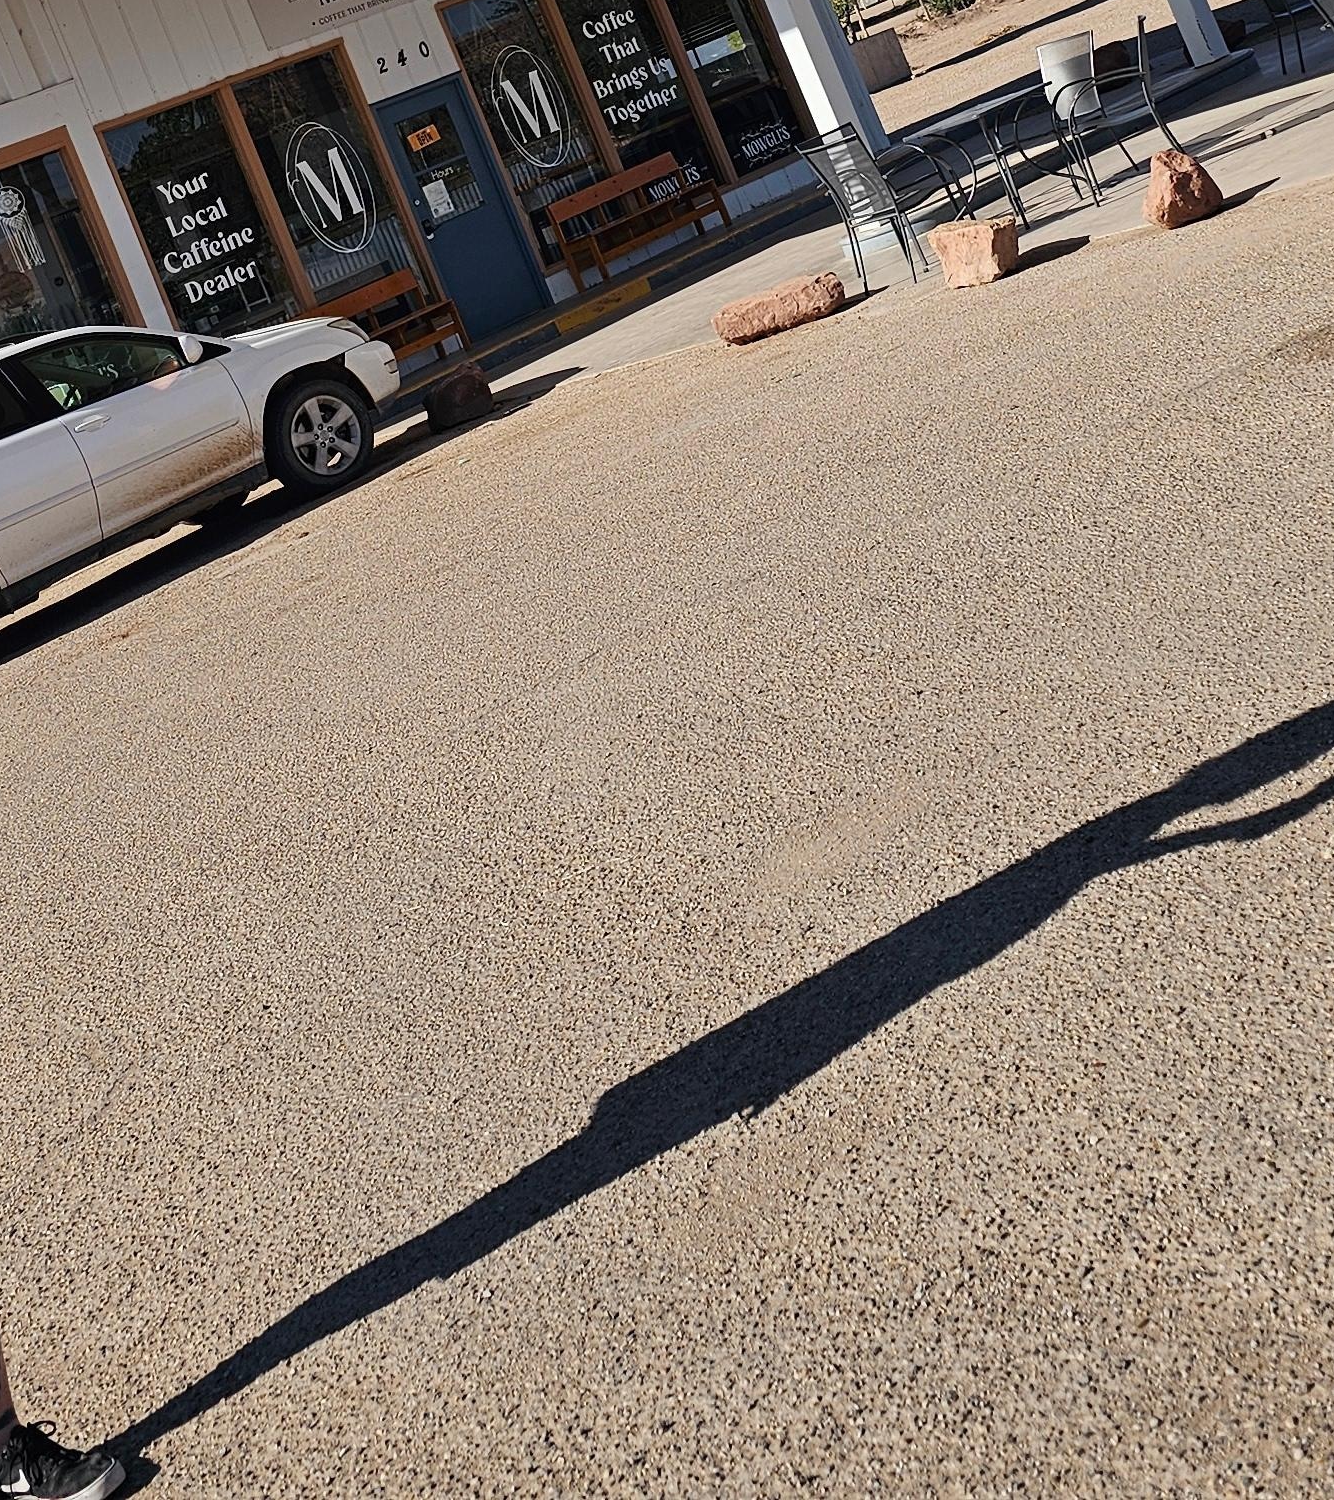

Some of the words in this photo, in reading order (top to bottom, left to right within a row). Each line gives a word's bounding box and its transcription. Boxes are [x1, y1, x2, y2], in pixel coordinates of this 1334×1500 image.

[319, 9, 347, 25] COFFEE
[347, 3, 367, 15] THAT
[582, 8, 636, 39] Coffee
[599, 36, 641, 64] That
[593, 63, 649, 100] Brings
[647, 54, 669, 77] Us
[500, 69, 560, 144] M
[603, 84, 678, 126] Together
[742, 125, 791, 160] MOWGLI'S
[156, 172, 209, 205] Your
[296, 146, 365, 229] M
[430, 166, 454, 180] Hours
[648, 166, 701, 201] MOWI'S
[165, 196, 228, 238] Local
[163, 227, 255, 274] Caffeine
[184, 261, 257, 304] Dealer
